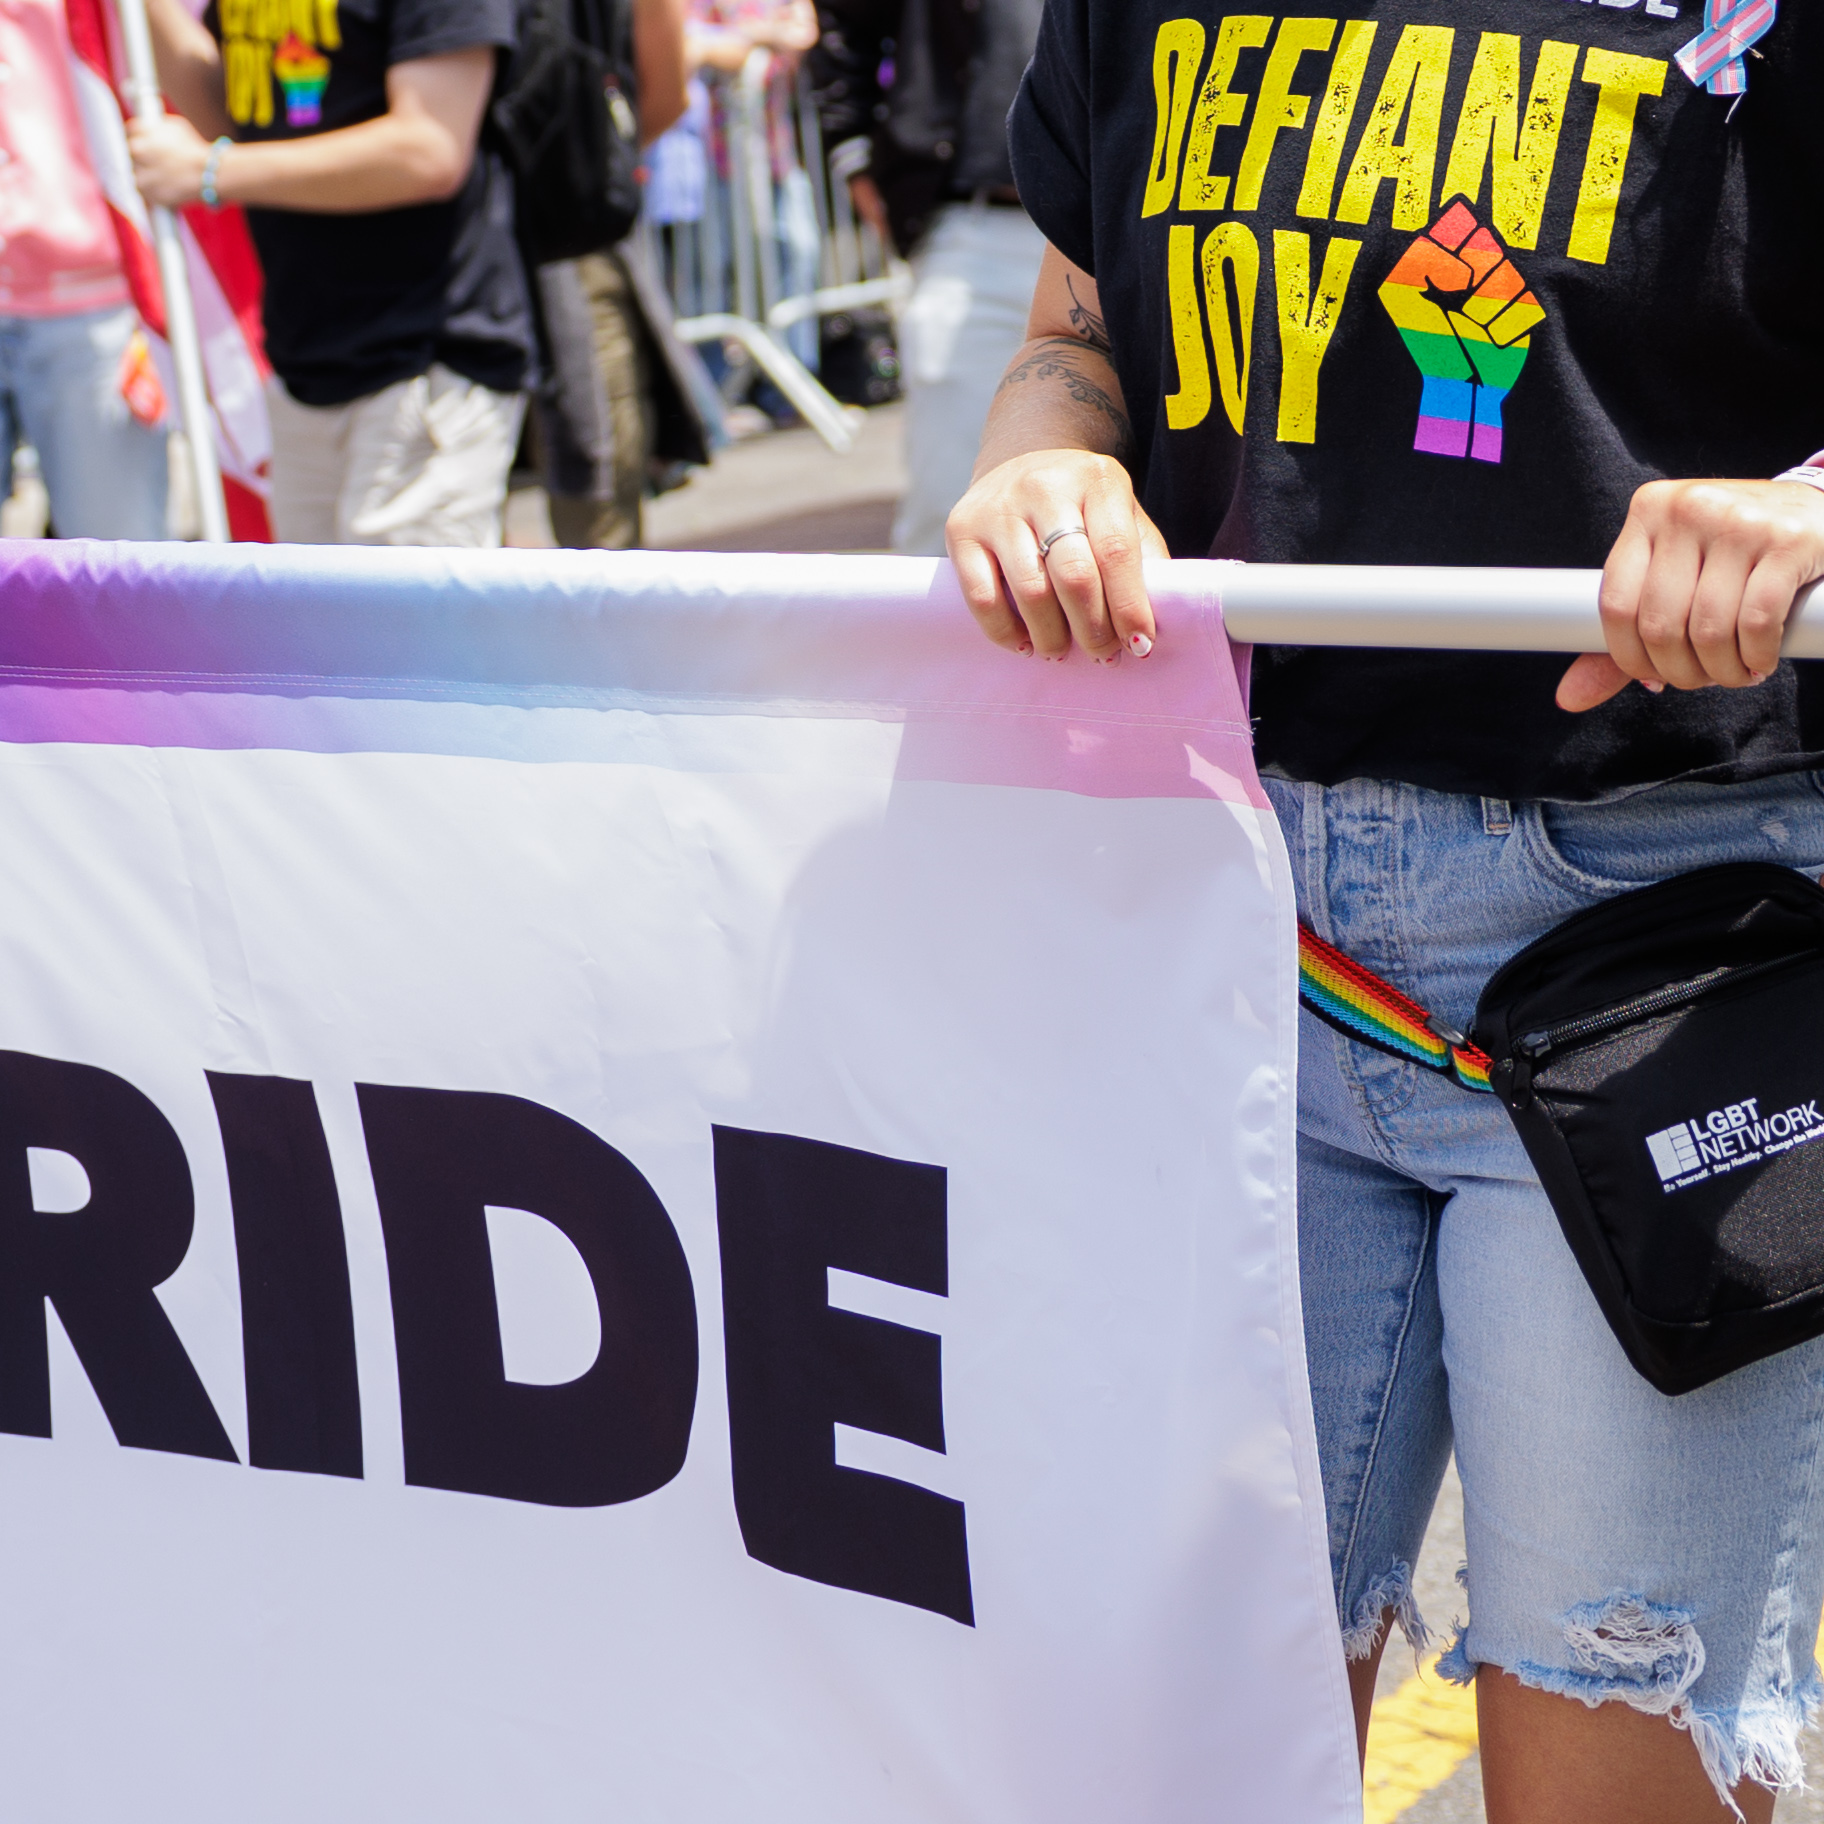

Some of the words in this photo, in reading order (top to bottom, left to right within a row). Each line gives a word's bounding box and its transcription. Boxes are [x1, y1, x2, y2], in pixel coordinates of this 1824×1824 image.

[1141, 14, 1669, 265] DEFIANT
[1165, 220, 1363, 445] JOY
[1689, 1097, 1759, 1141] LGBT
[1698, 1099, 1824, 1164] NETWORK
[1713, 1162, 1731, 1175] Stay
[1764, 1138, 1794, 1155] Change
